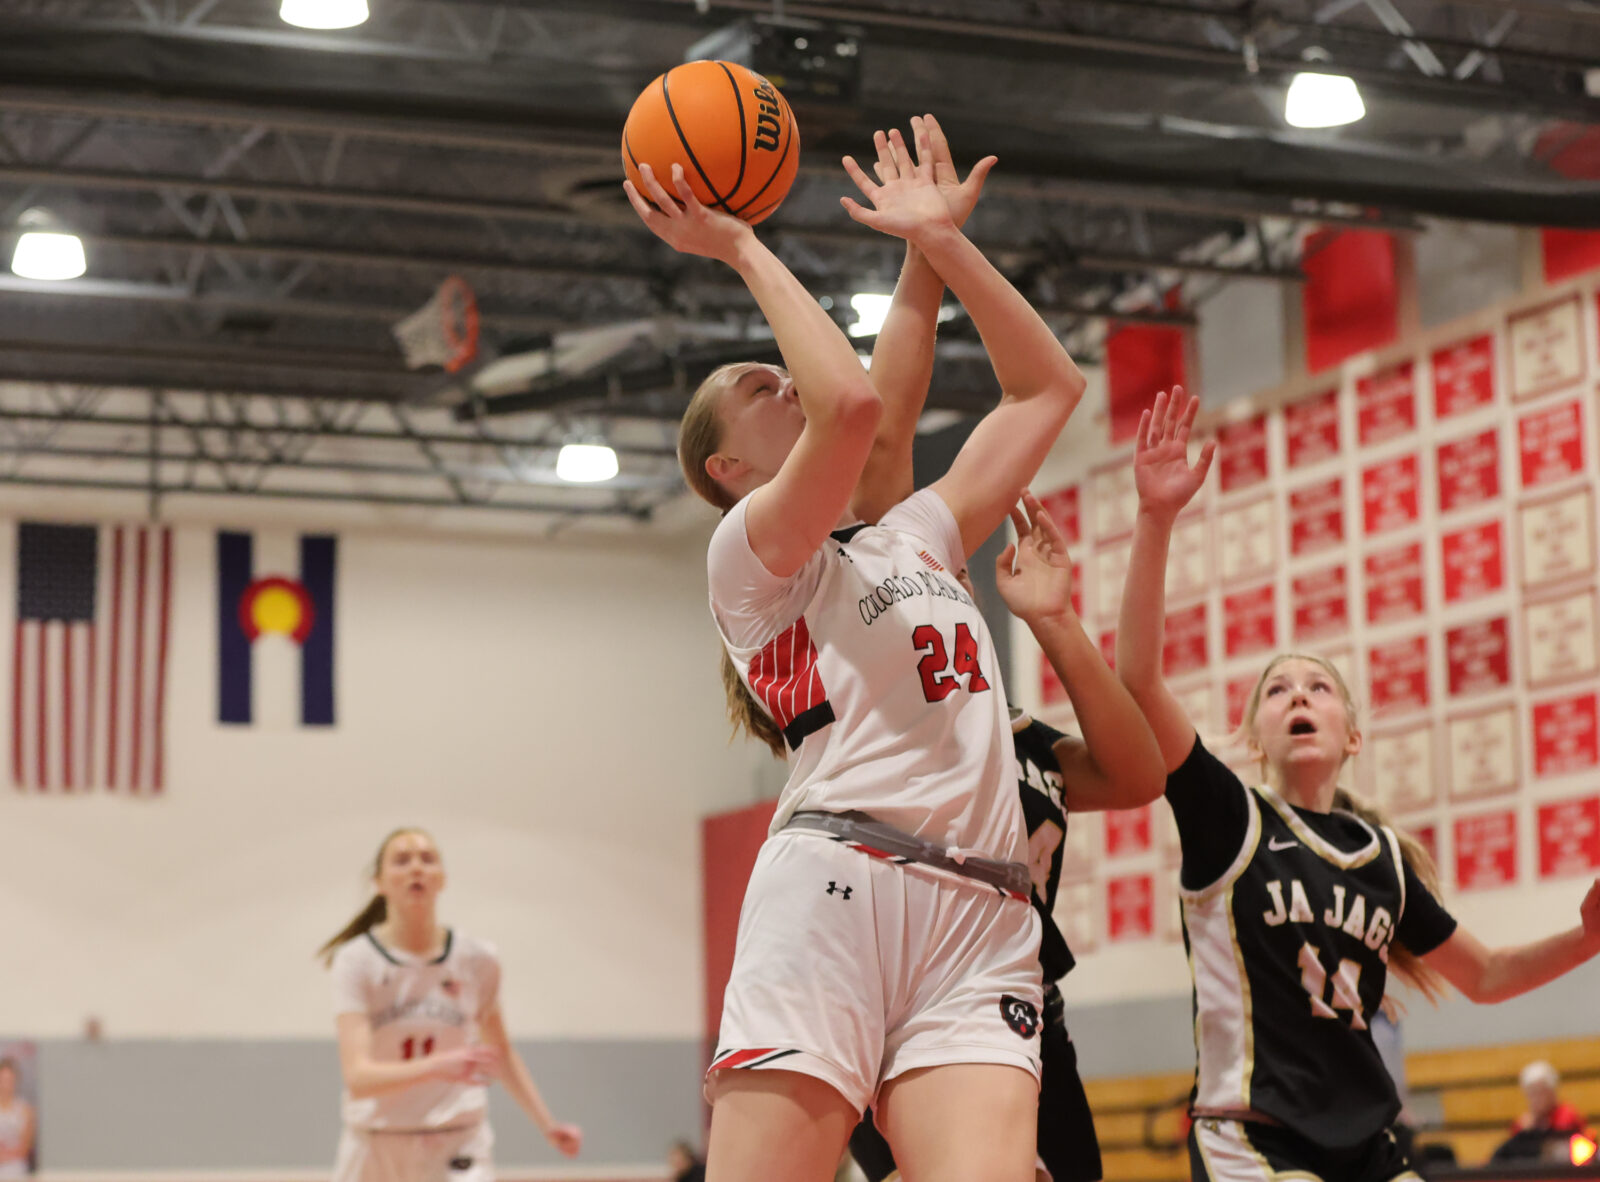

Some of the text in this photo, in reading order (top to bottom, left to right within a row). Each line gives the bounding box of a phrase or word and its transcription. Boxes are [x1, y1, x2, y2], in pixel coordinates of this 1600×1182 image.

[858, 575, 923, 626] COLORADO
[912, 622, 991, 704] 24
[1263, 879, 1315, 928] JA
[1297, 940, 1368, 1031] 14
